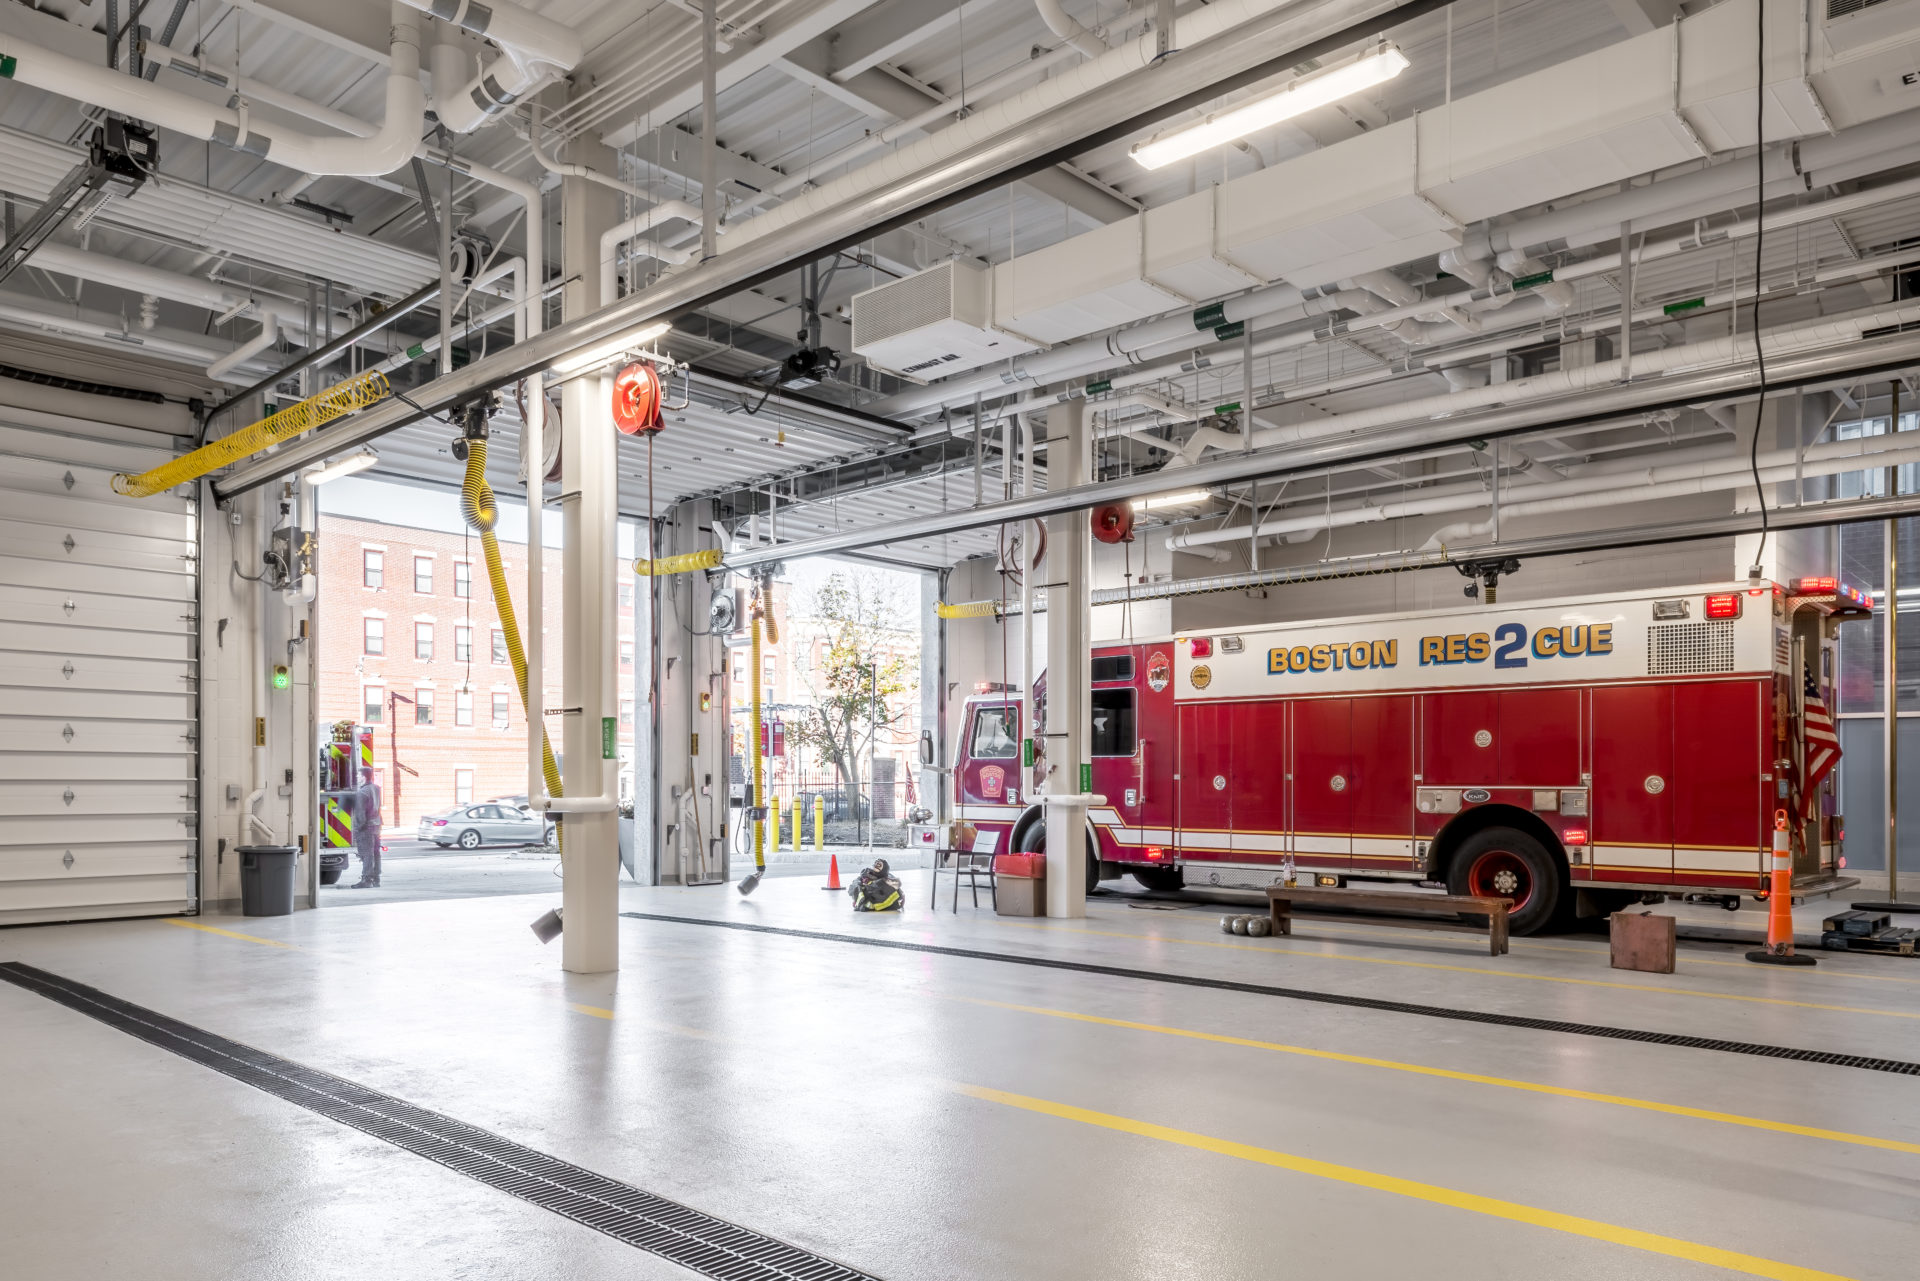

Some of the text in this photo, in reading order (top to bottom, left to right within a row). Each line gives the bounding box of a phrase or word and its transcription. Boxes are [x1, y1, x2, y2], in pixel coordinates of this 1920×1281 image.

[1902, 71, 1920, 86] E
[901, 354, 961, 373] EXHAUST AIR
[1267, 638, 1398, 676] BOSTON
